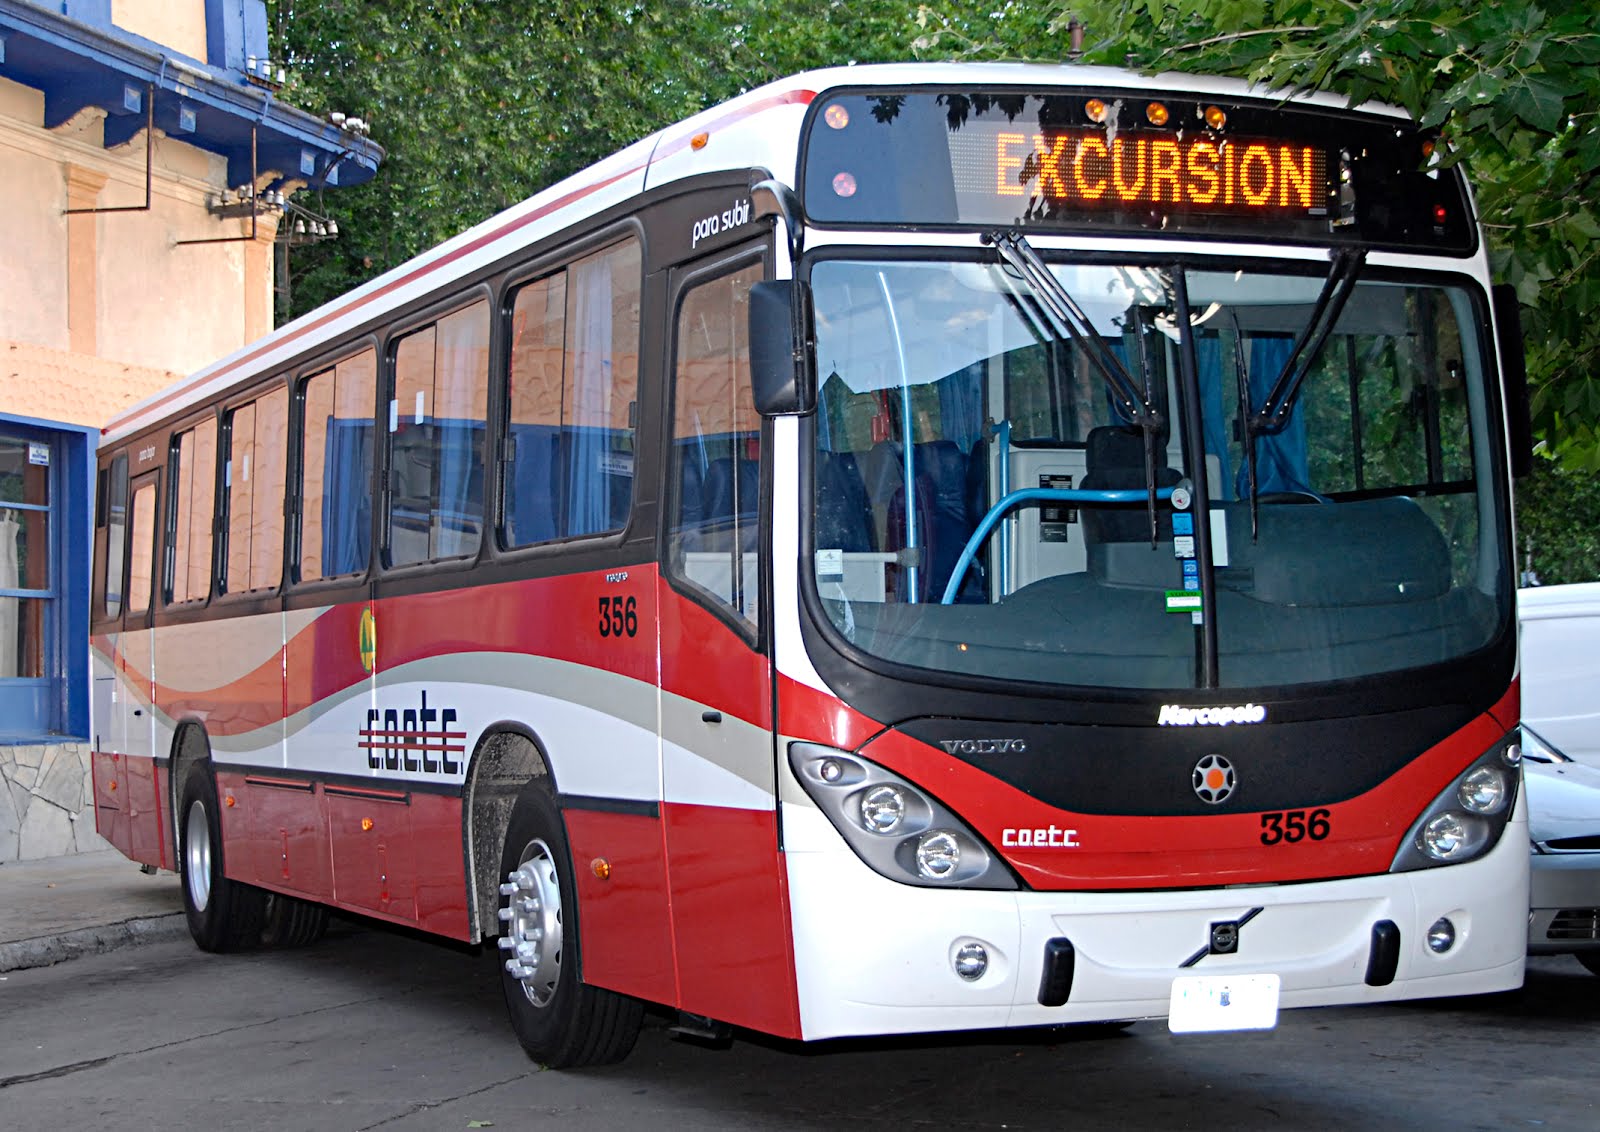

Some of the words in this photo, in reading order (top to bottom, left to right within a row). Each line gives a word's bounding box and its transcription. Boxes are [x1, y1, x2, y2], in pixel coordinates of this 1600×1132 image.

[997, 132, 1312, 208] EXCURSION
[692, 214, 719, 249] para
[721, 199, 750, 232] subir
[598, 595, 638, 638] 356
[1157, 703, 1267, 726] Marcopolo
[939, 738, 1026, 754] VOLVO
[1260, 808, 1331, 846] 356
